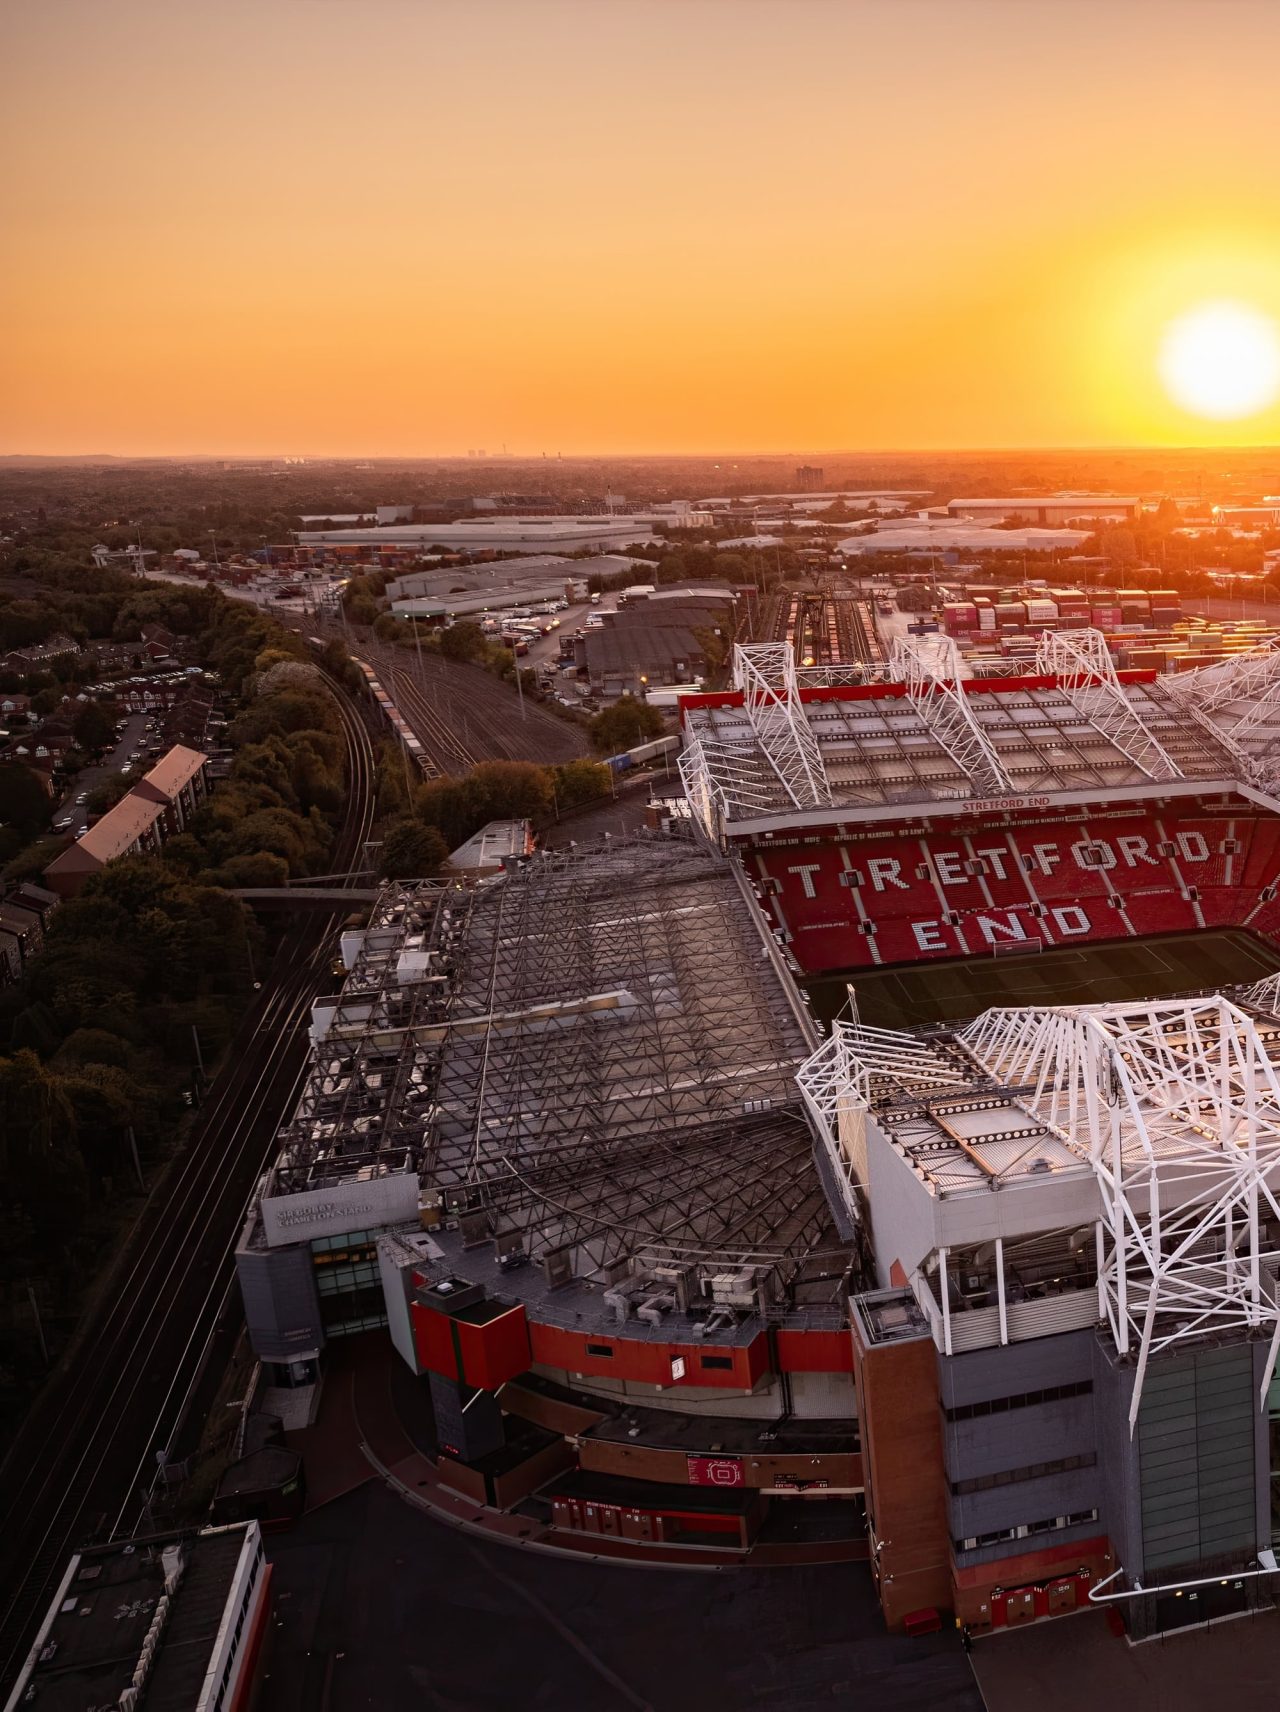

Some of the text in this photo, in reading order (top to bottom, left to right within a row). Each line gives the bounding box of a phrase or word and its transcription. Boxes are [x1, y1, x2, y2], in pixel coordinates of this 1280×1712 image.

[963, 797, 1050, 812] STRETFORD END
[788, 832, 1210, 898] TRETFORD
[911, 906, 1092, 951] END
